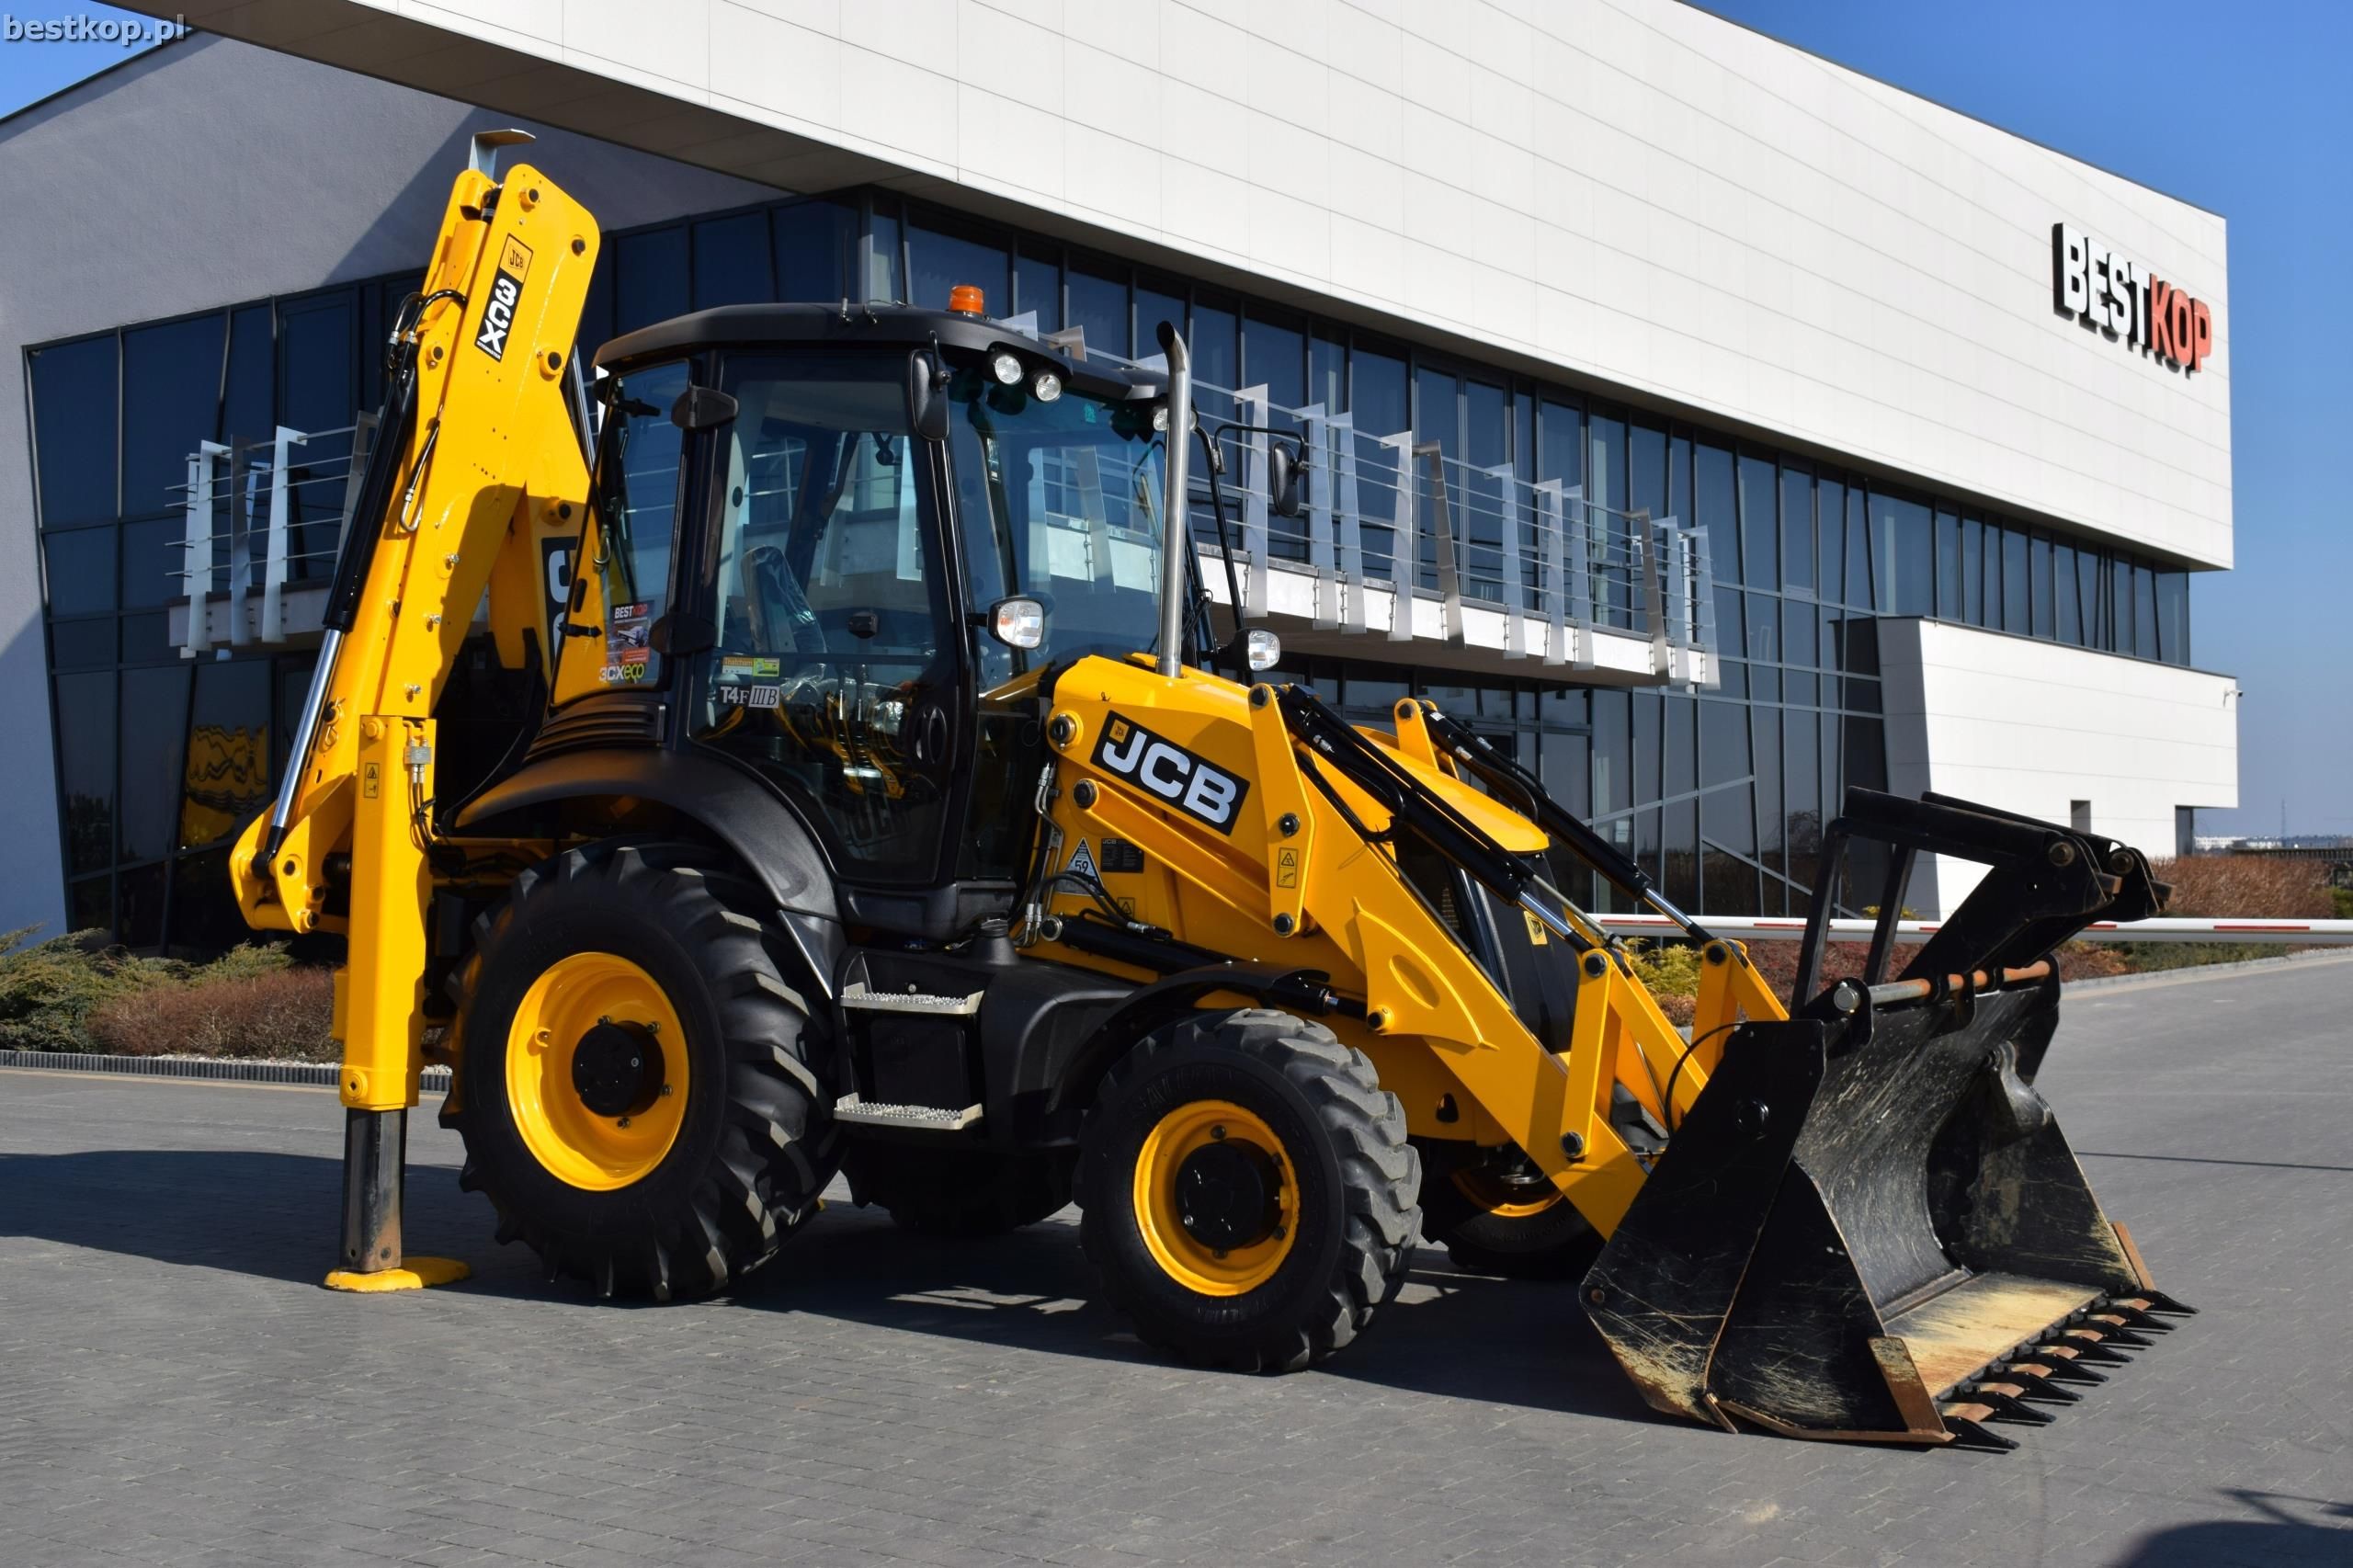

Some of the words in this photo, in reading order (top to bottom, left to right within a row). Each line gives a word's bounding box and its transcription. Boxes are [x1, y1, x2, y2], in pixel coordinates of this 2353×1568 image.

[508, 249, 524, 268] JCB
[477, 278, 517, 355] 3CX
[2054, 222, 2212, 374] BESTKOP
[1103, 731, 1237, 824] JCB
[1074, 859, 1089, 874] 59
